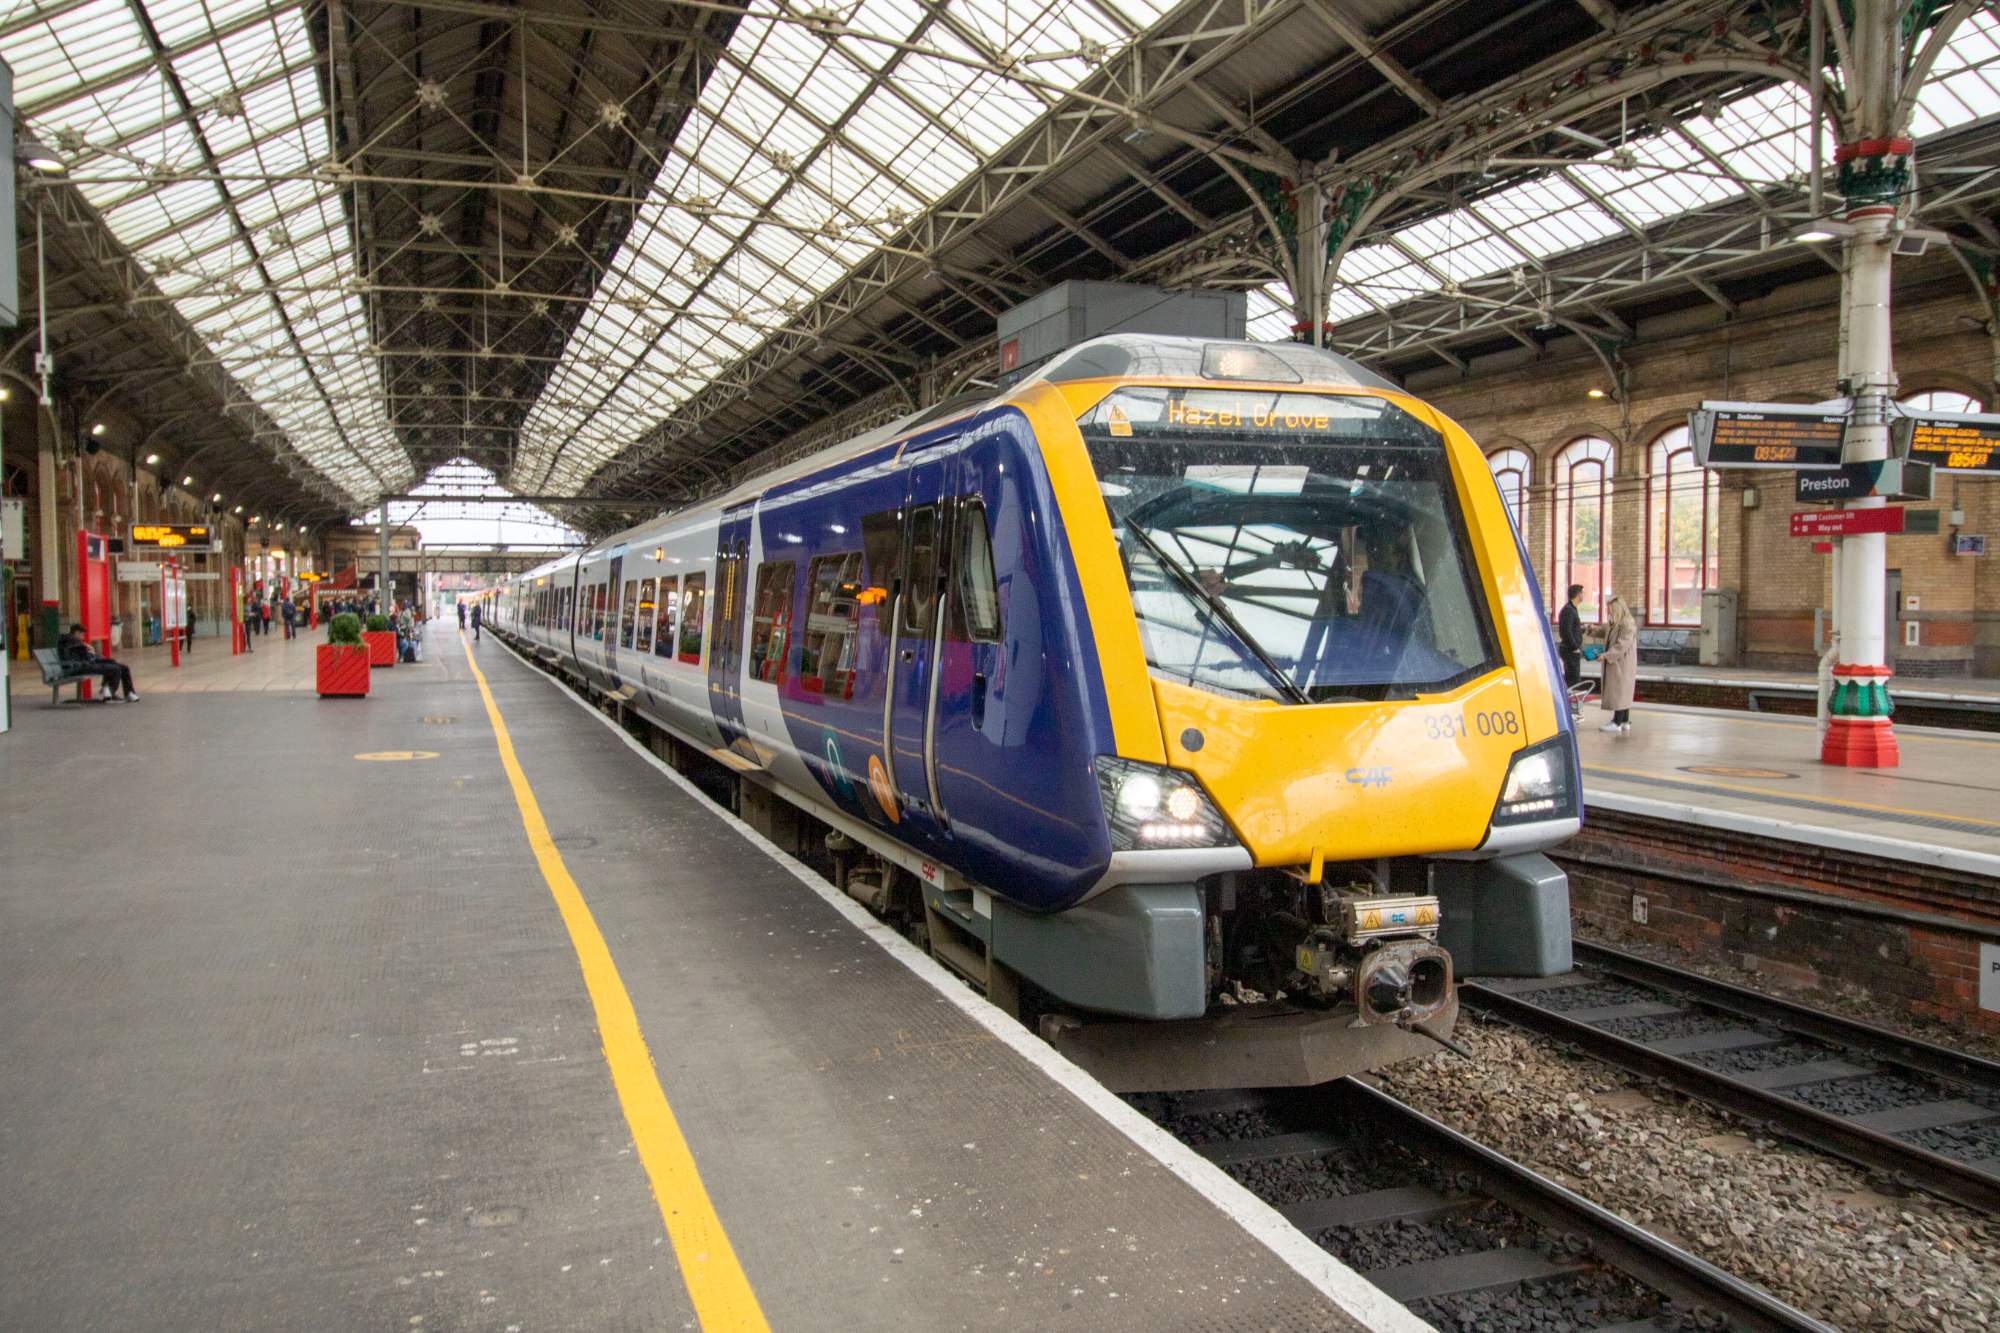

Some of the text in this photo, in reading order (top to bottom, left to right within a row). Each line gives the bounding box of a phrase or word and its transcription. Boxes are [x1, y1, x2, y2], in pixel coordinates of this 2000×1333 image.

[1168, 399, 1329, 429] Hazel Grove
[1800, 477, 1850, 491] Preston
[1424, 711, 1519, 740] 331 008
[1344, 767, 1393, 788] CAF
